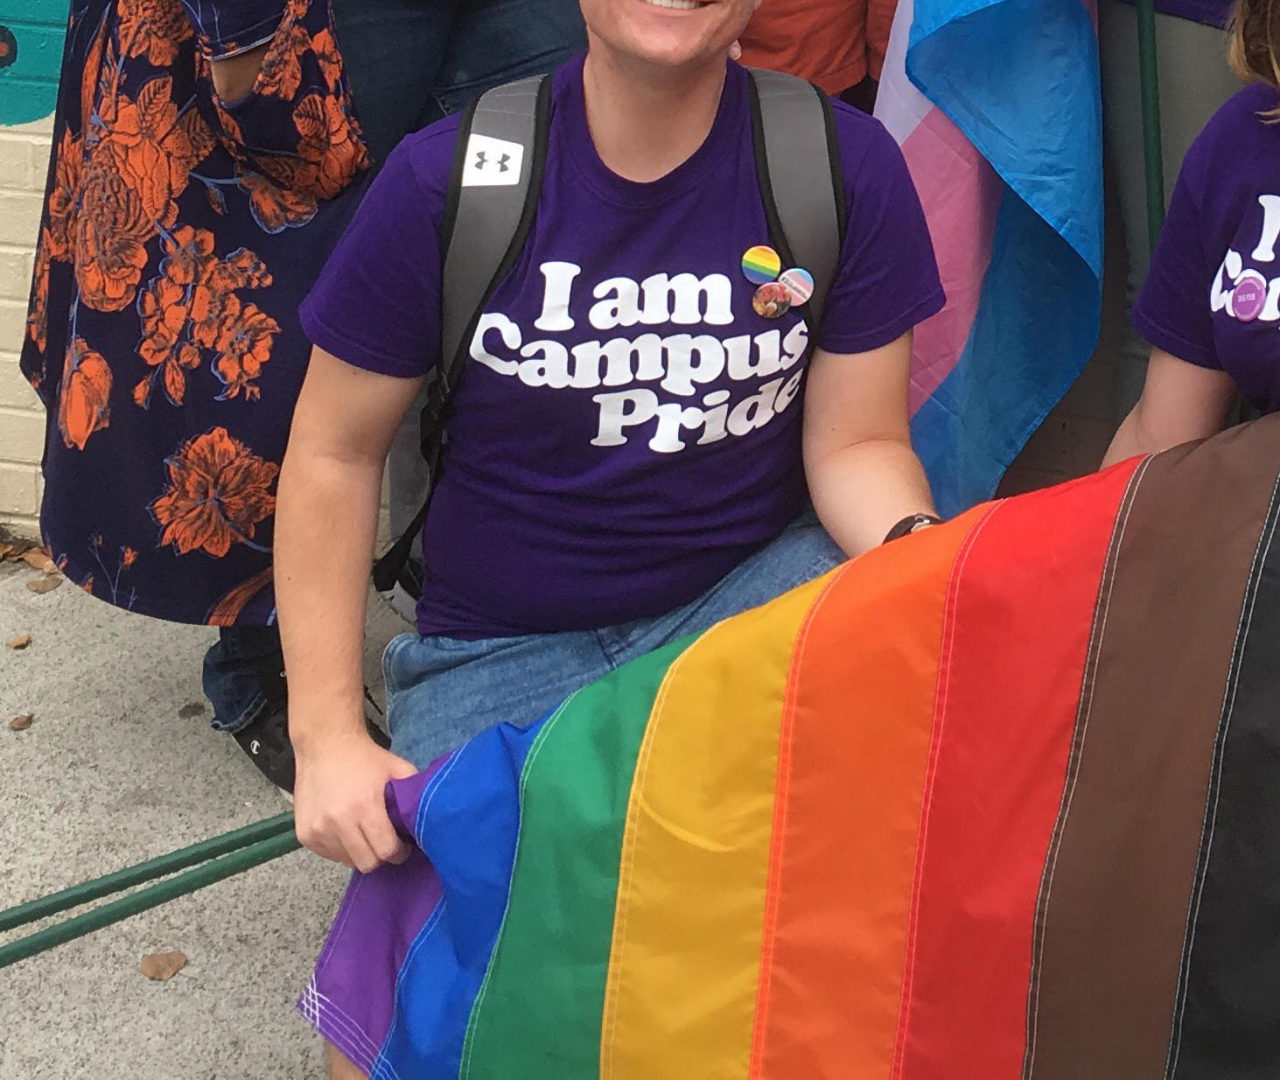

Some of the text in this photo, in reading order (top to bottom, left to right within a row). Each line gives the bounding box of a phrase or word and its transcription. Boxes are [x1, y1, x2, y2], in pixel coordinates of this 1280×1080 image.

[534, 262, 734, 331] I am
[469, 313, 808, 396] Campus
[590, 368, 804, 453] Pride
